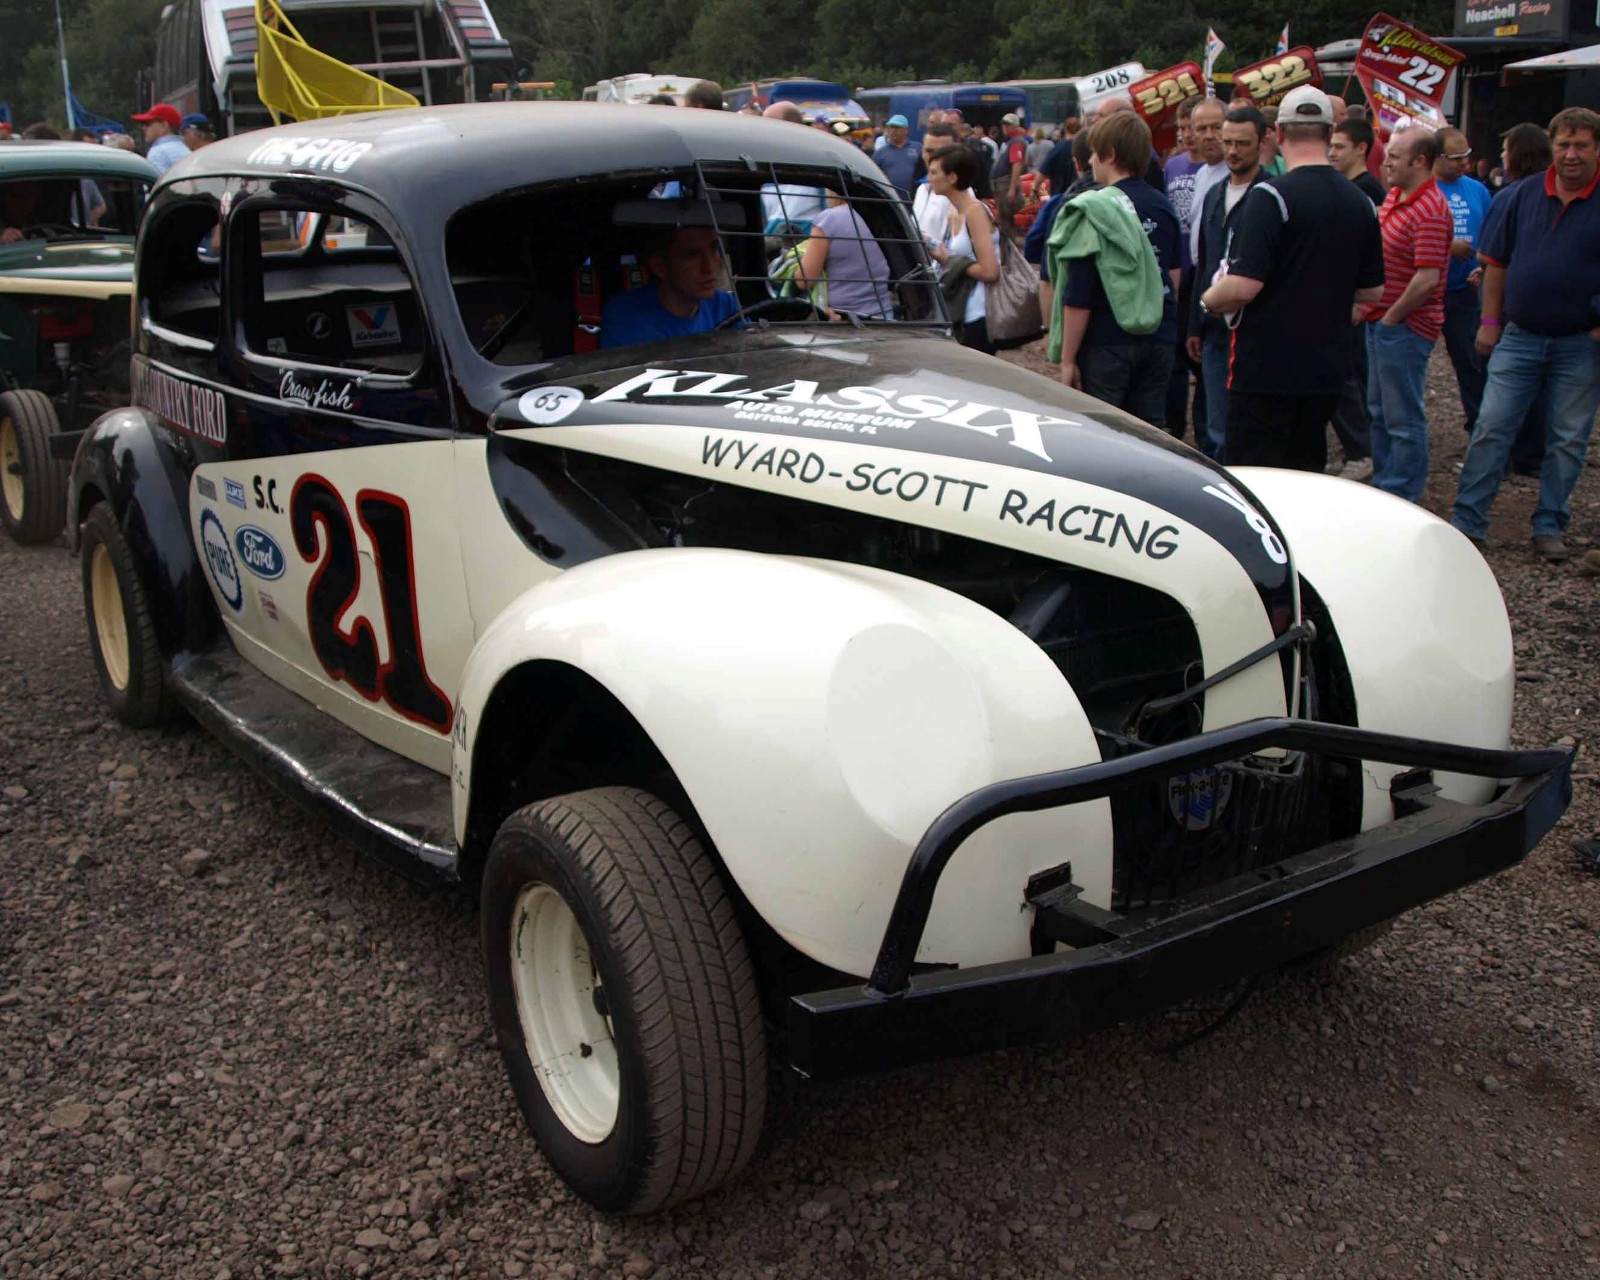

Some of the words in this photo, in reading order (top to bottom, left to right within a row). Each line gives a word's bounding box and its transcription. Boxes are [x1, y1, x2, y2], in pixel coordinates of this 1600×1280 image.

[1091, 68, 1131, 93] 208
[1135, 72, 1199, 114] 321
[1238, 55, 1313, 99] 322
[1398, 55, 1447, 96] 22
[191, 383, 227, 443] FORD
[533, 391, 570, 412] 65
[590, 368, 1083, 463] KLASSIX
[724, 400, 795, 415] AUTO
[798, 407, 917, 430] MUSEUM
[734, 411, 799, 425] DAYTONA
[859, 425, 878, 435] FL
[253, 474, 285, 515] S.C.
[701, 434, 989, 513] WYARD-SCOTT
[999, 488, 1181, 560] RACING
[1201, 482, 1289, 565] V8
[206, 539, 236, 583] PURE
[243, 530, 276, 571] Ford
[289, 472, 454, 735] 21
